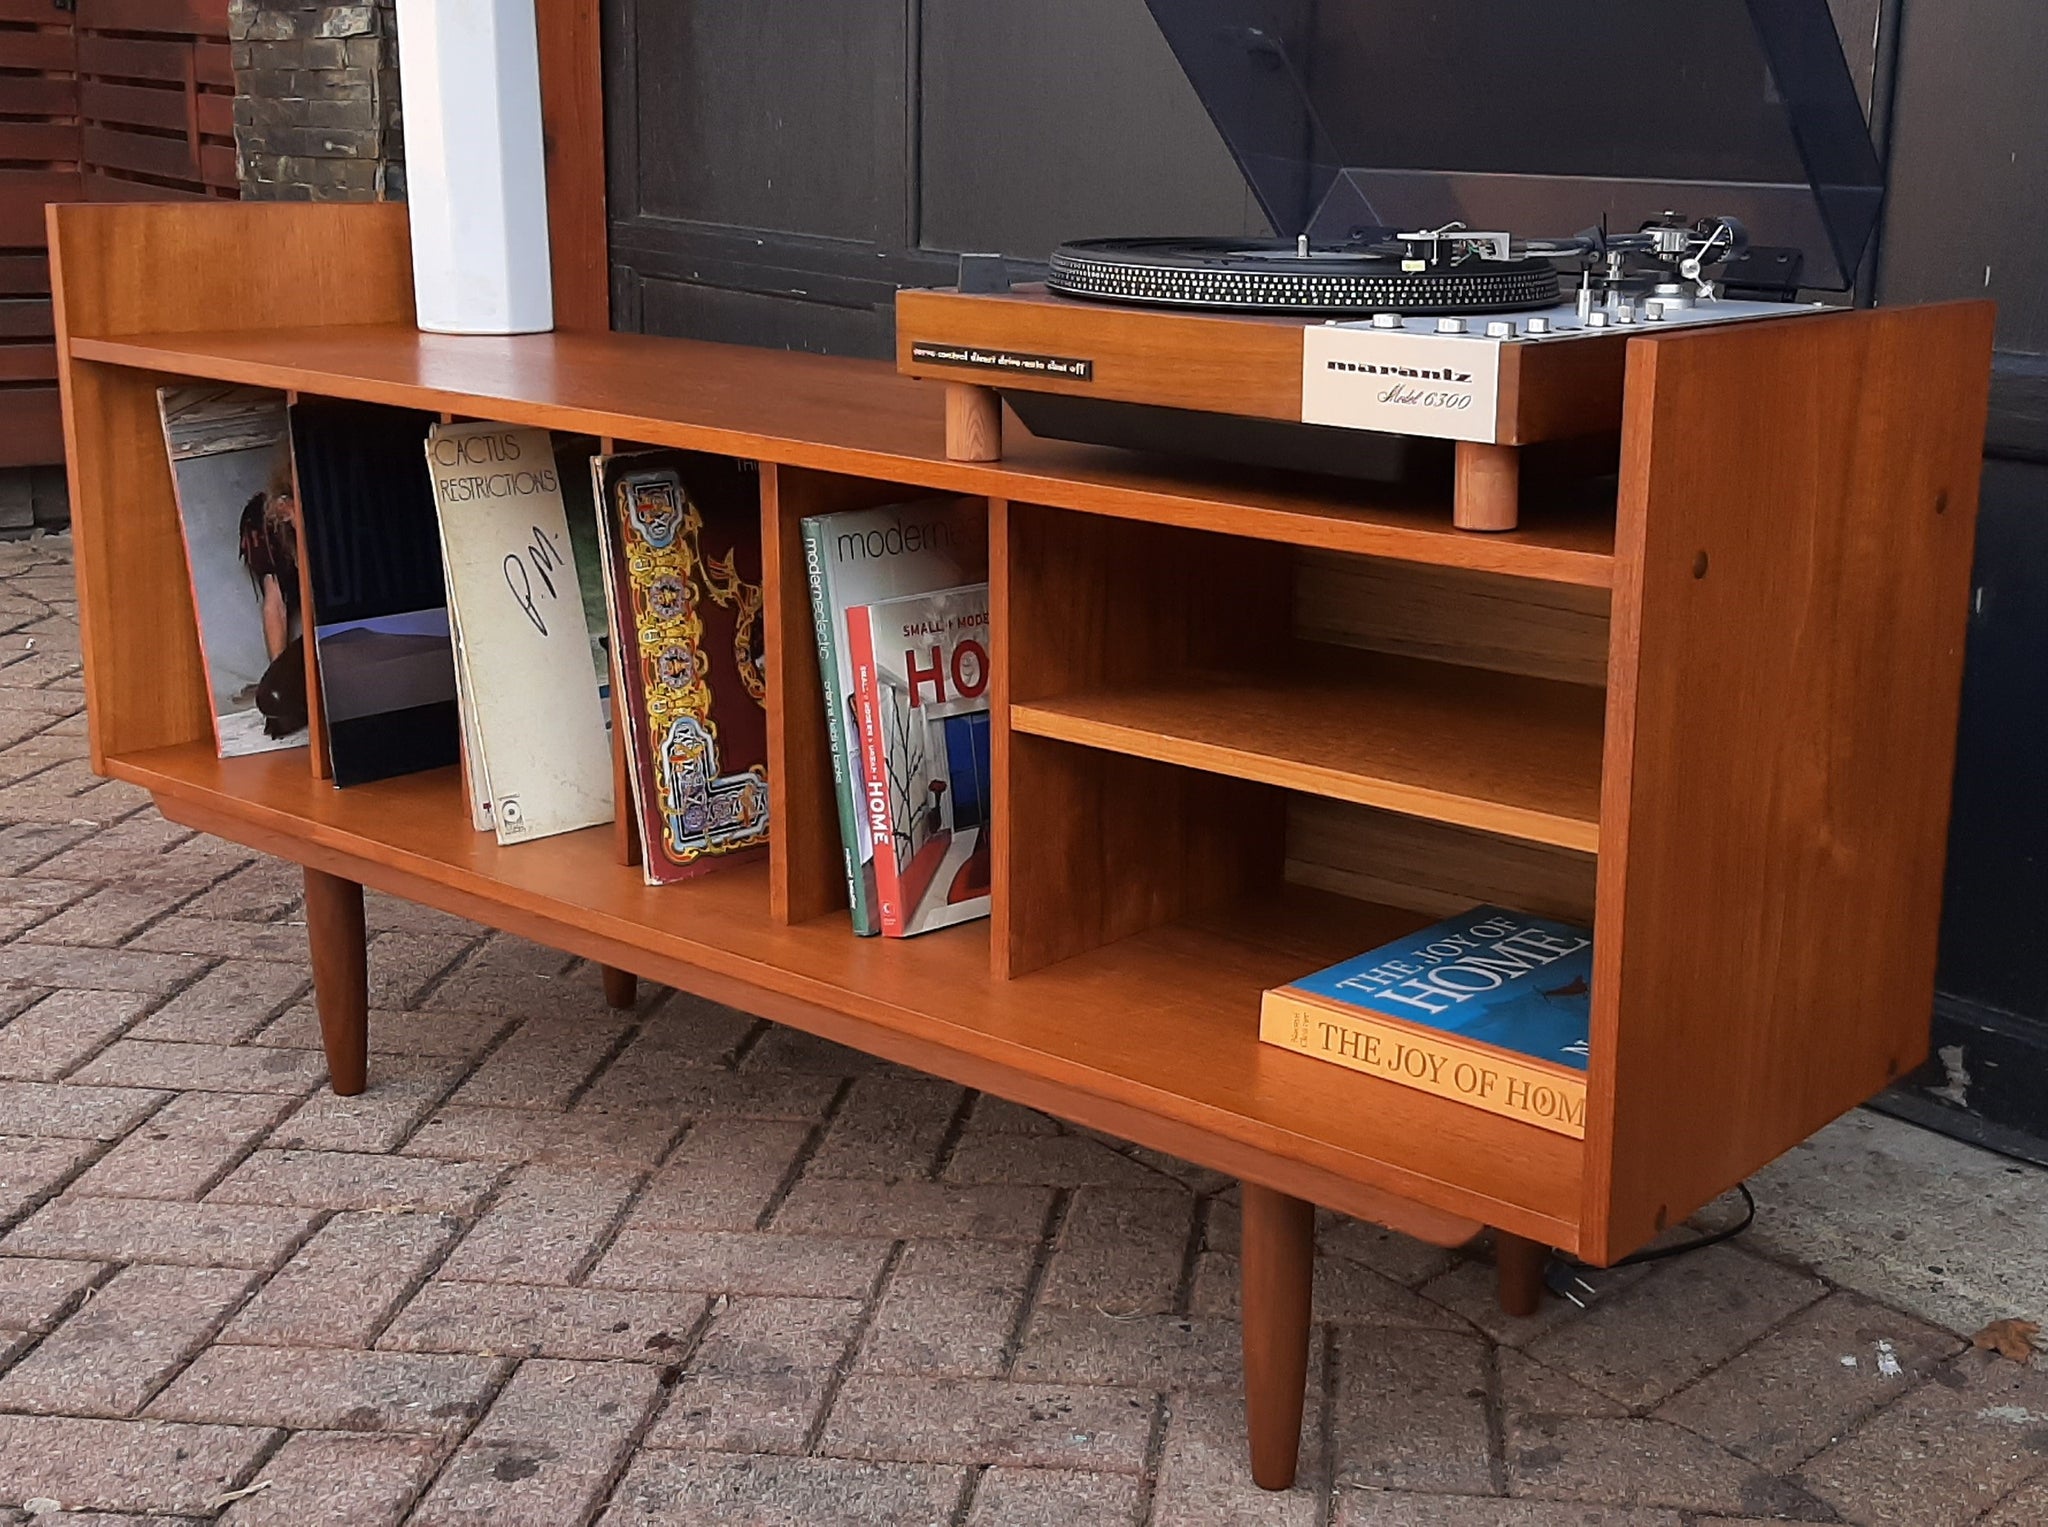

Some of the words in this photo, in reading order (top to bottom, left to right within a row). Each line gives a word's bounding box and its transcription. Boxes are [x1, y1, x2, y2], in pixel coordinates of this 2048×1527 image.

[1327, 360, 1473, 383] marantz
[1424, 393, 1472, 410] 6300
[434, 434, 521, 466] CACTUS
[440, 470, 557, 502] RESTRICTIONS
[903, 621, 945, 637] SMALL
[868, 781, 889, 845] HOME
[1336, 959, 1425, 993] THE
[1411, 933, 1481, 967] JOY
[1469, 916, 1520, 939] OF
[1374, 928, 1592, 1015] HOME
[1318, 1022, 1381, 1066] THE
[1388, 1043, 1448, 1085] JOY
[1454, 1063, 1498, 1098] OF
